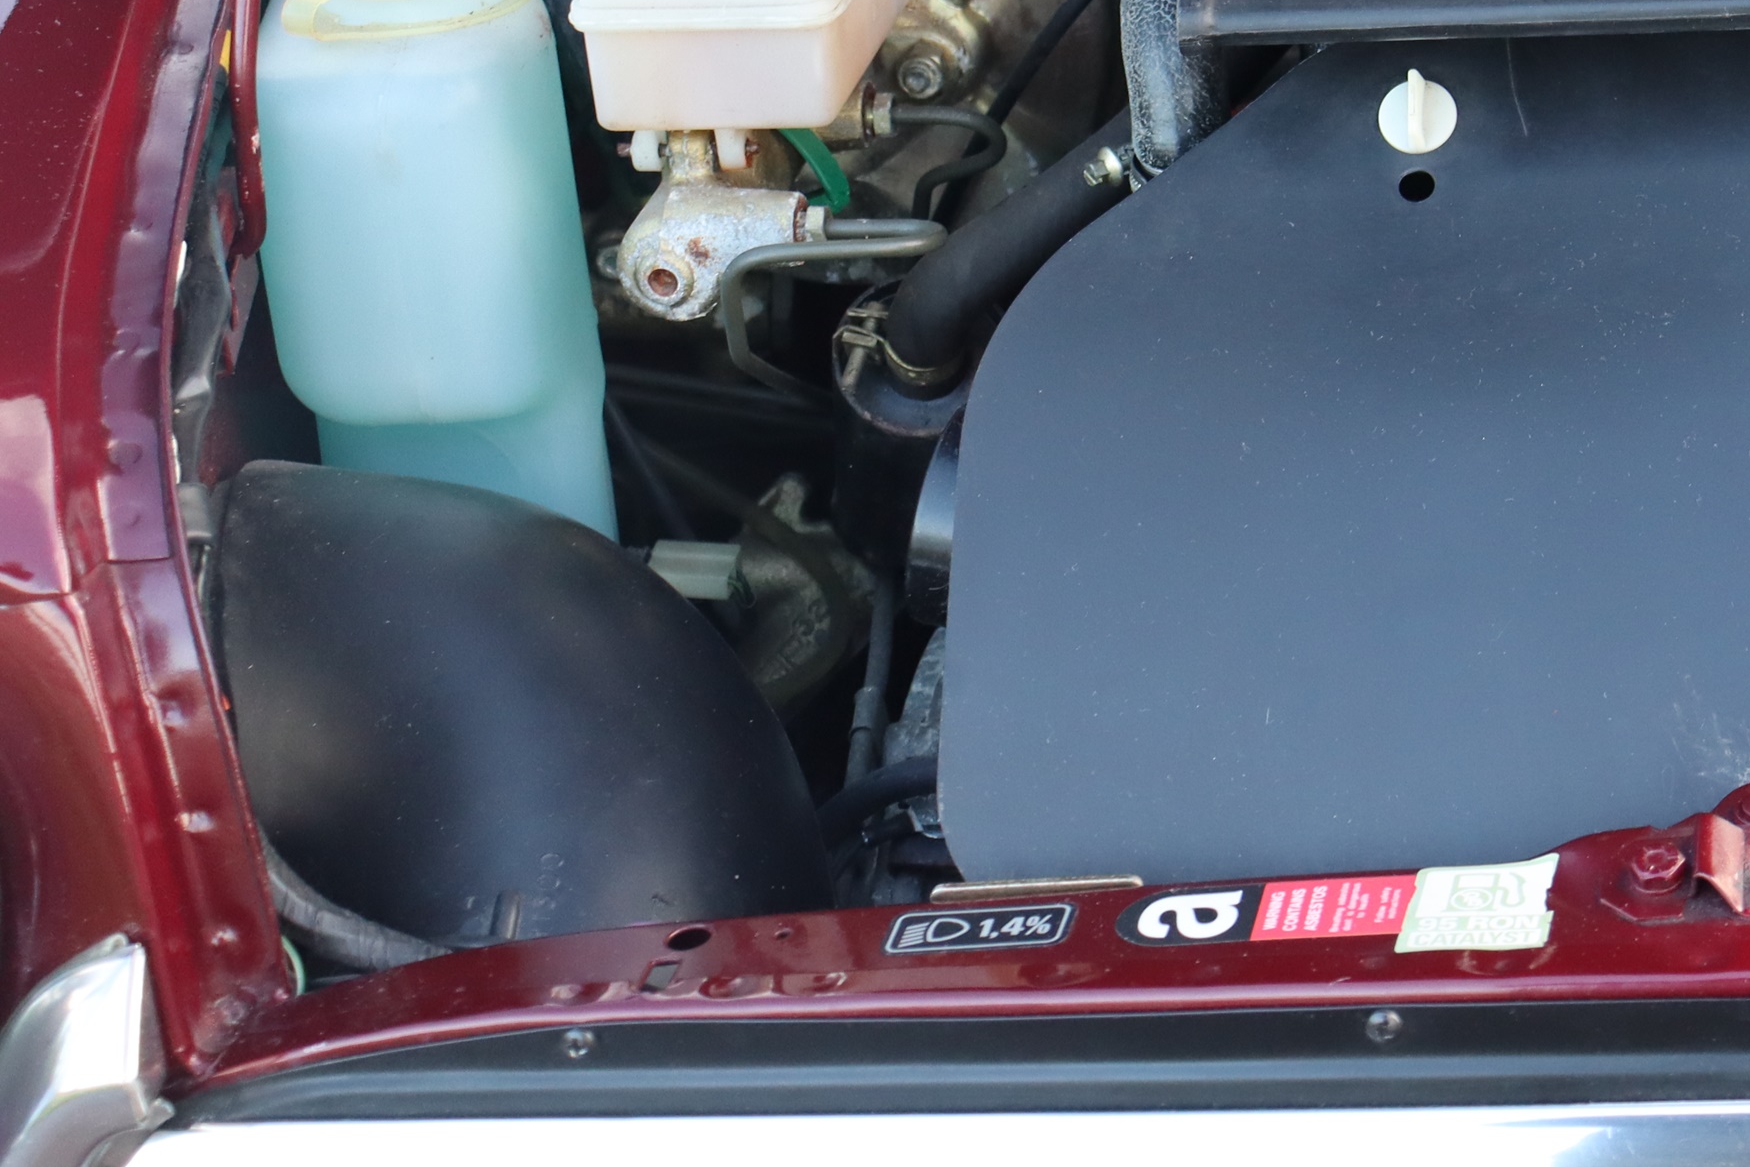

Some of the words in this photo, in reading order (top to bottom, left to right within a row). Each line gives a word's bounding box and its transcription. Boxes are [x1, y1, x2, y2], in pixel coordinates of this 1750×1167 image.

[979, 914, 1053, 939] 1,4%
[1136, 889, 1244, 939] a
[1262, 891, 1286, 931] WARNING
[1282, 888, 1308, 932] CONTAINS
[1304, 885, 1328, 932] ASBESTOS
[1417, 916, 1459, 931] 95
[1467, 915, 1541, 930] RON
[1415, 930, 1535, 946] CATALYST
